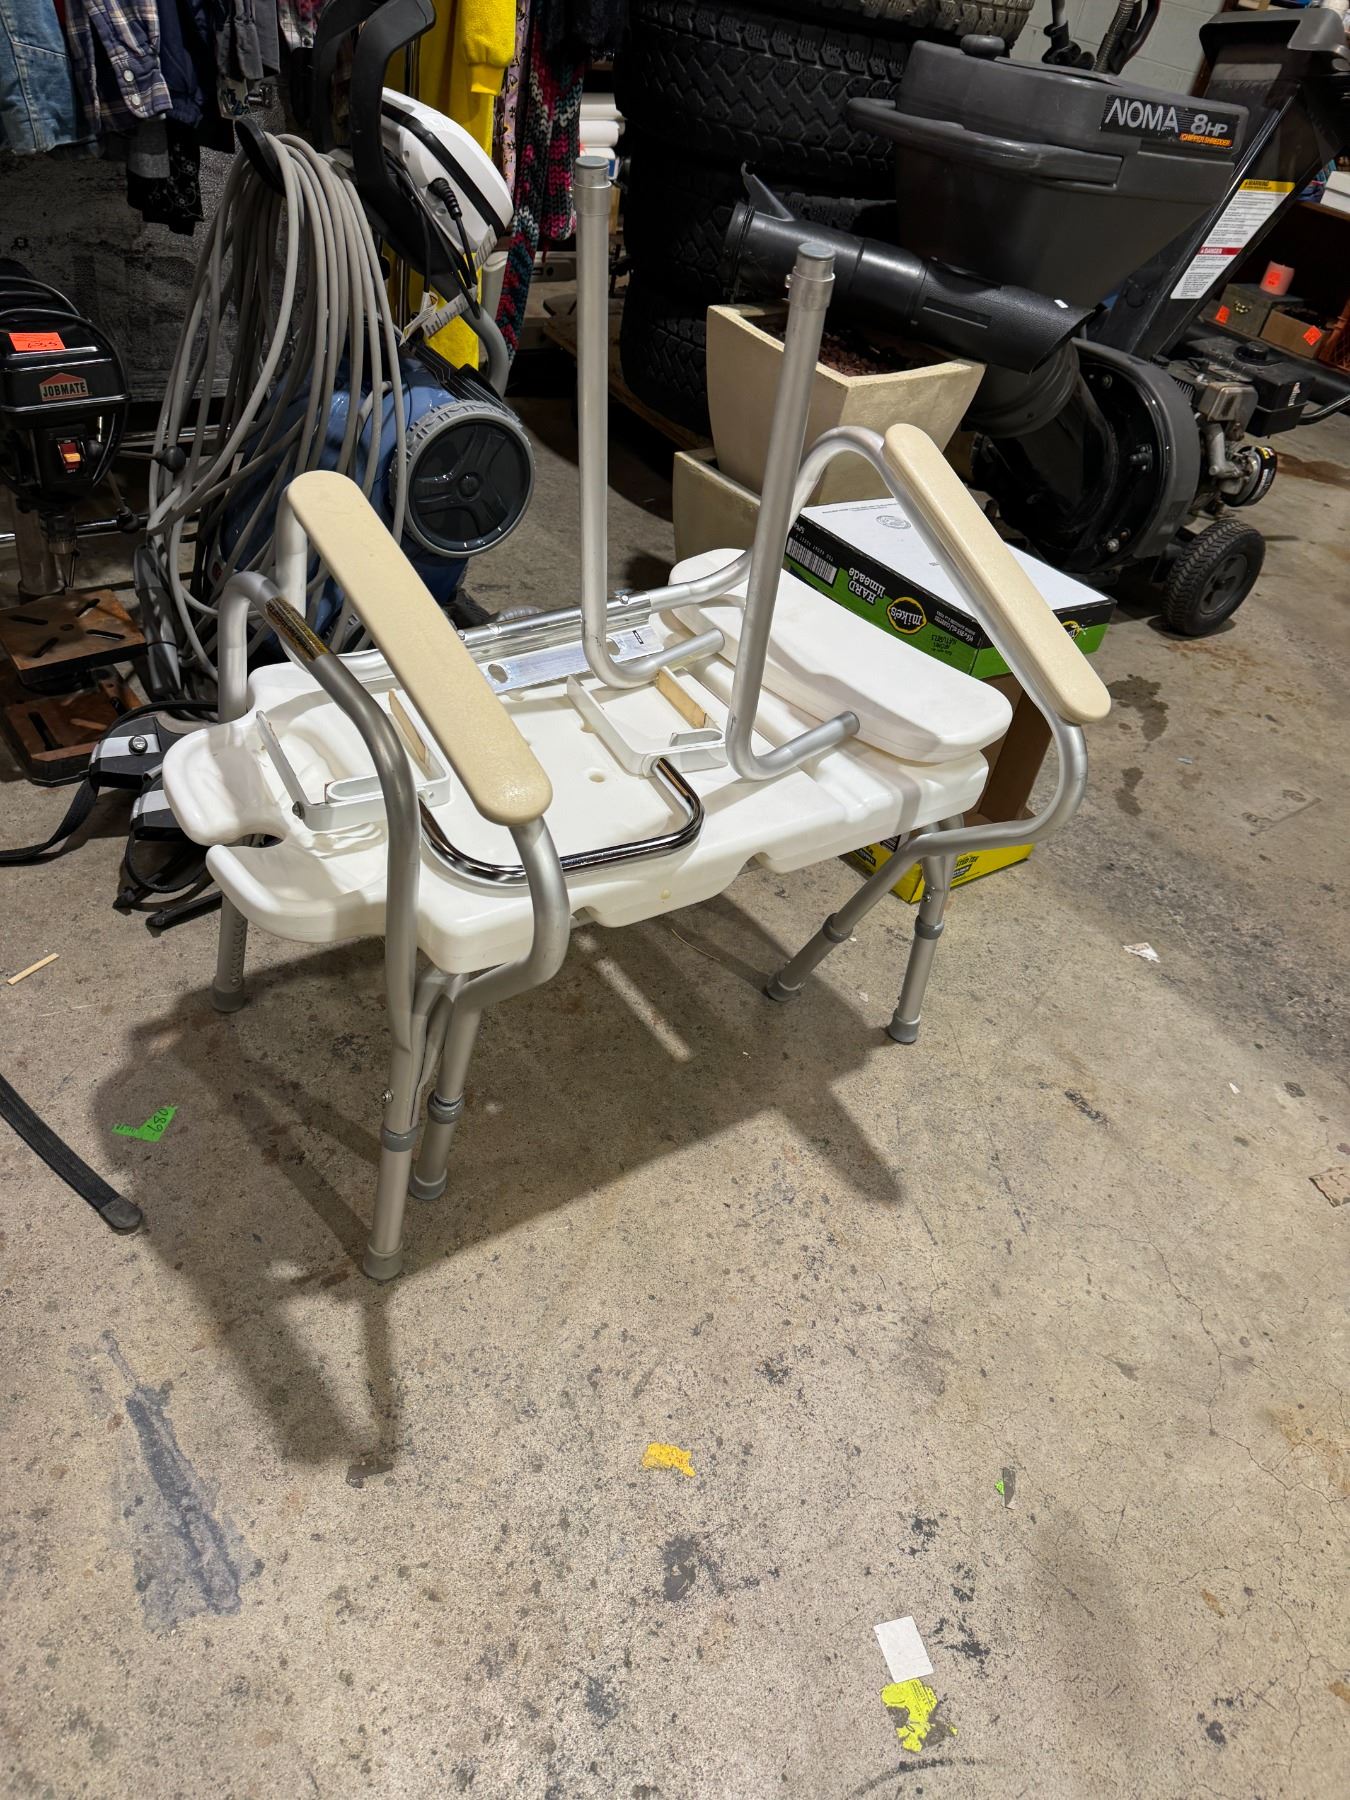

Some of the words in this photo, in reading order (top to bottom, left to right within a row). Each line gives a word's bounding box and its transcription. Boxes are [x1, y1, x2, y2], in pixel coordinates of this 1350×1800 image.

[1105, 98, 1178, 132] NOMA
[42, 382, 86, 397] JOBMATE
[848, 567, 886, 597] limeade
[848, 580, 877, 604] HARD
[890, 607, 923, 625] mike's
